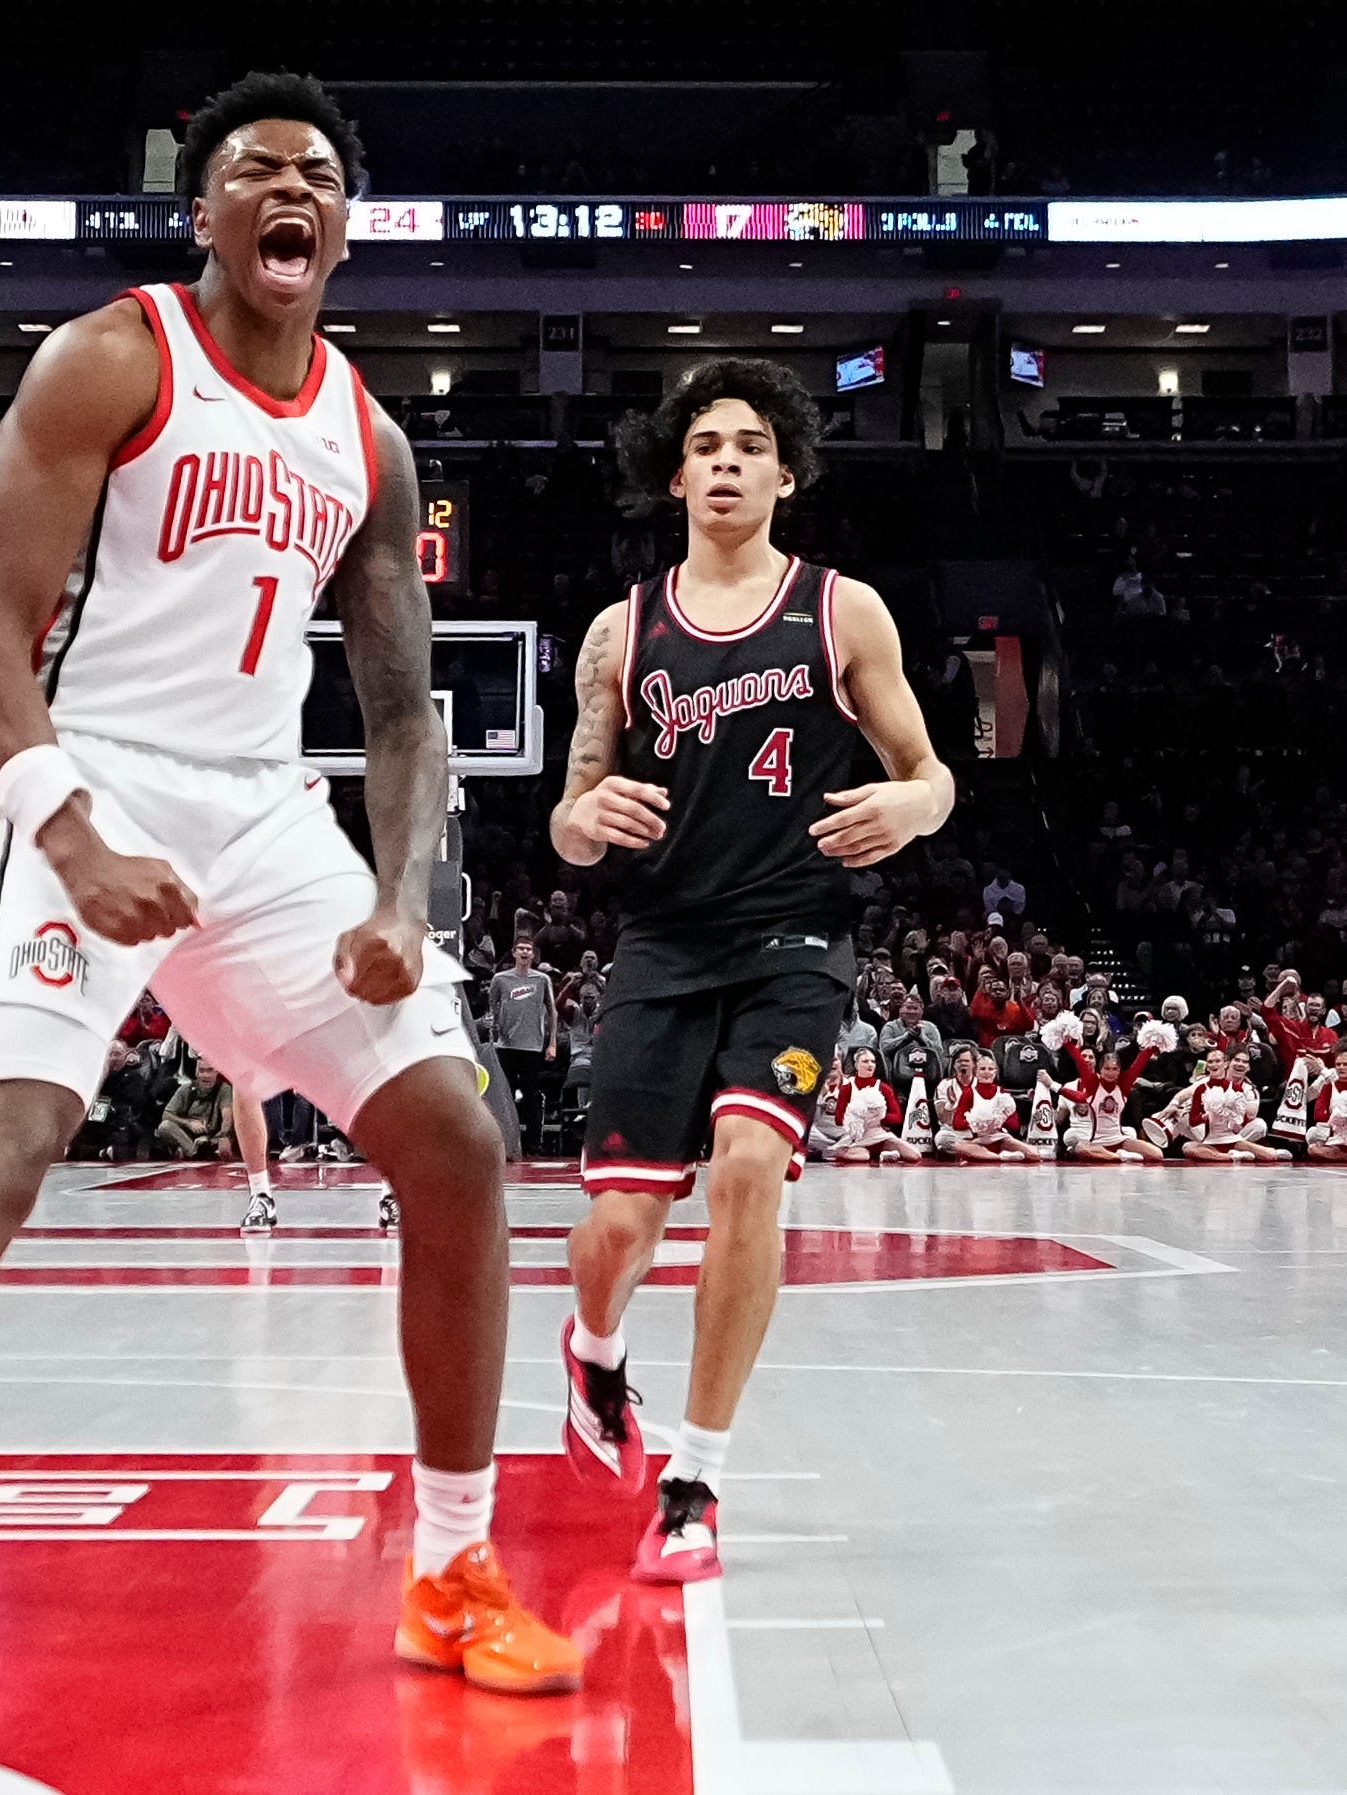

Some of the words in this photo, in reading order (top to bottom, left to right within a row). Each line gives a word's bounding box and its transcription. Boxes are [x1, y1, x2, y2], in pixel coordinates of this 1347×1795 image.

[370, 207, 420, 233] 24
[511, 204, 623, 237] 13:12
[715, 204, 751, 238] 17
[157, 451, 264, 563] OHIO
[428, 500, 453, 528] 12
[238, 575, 280, 678] 1
[640, 664, 814, 760] Jaguars
[747, 727, 795, 797] 4
